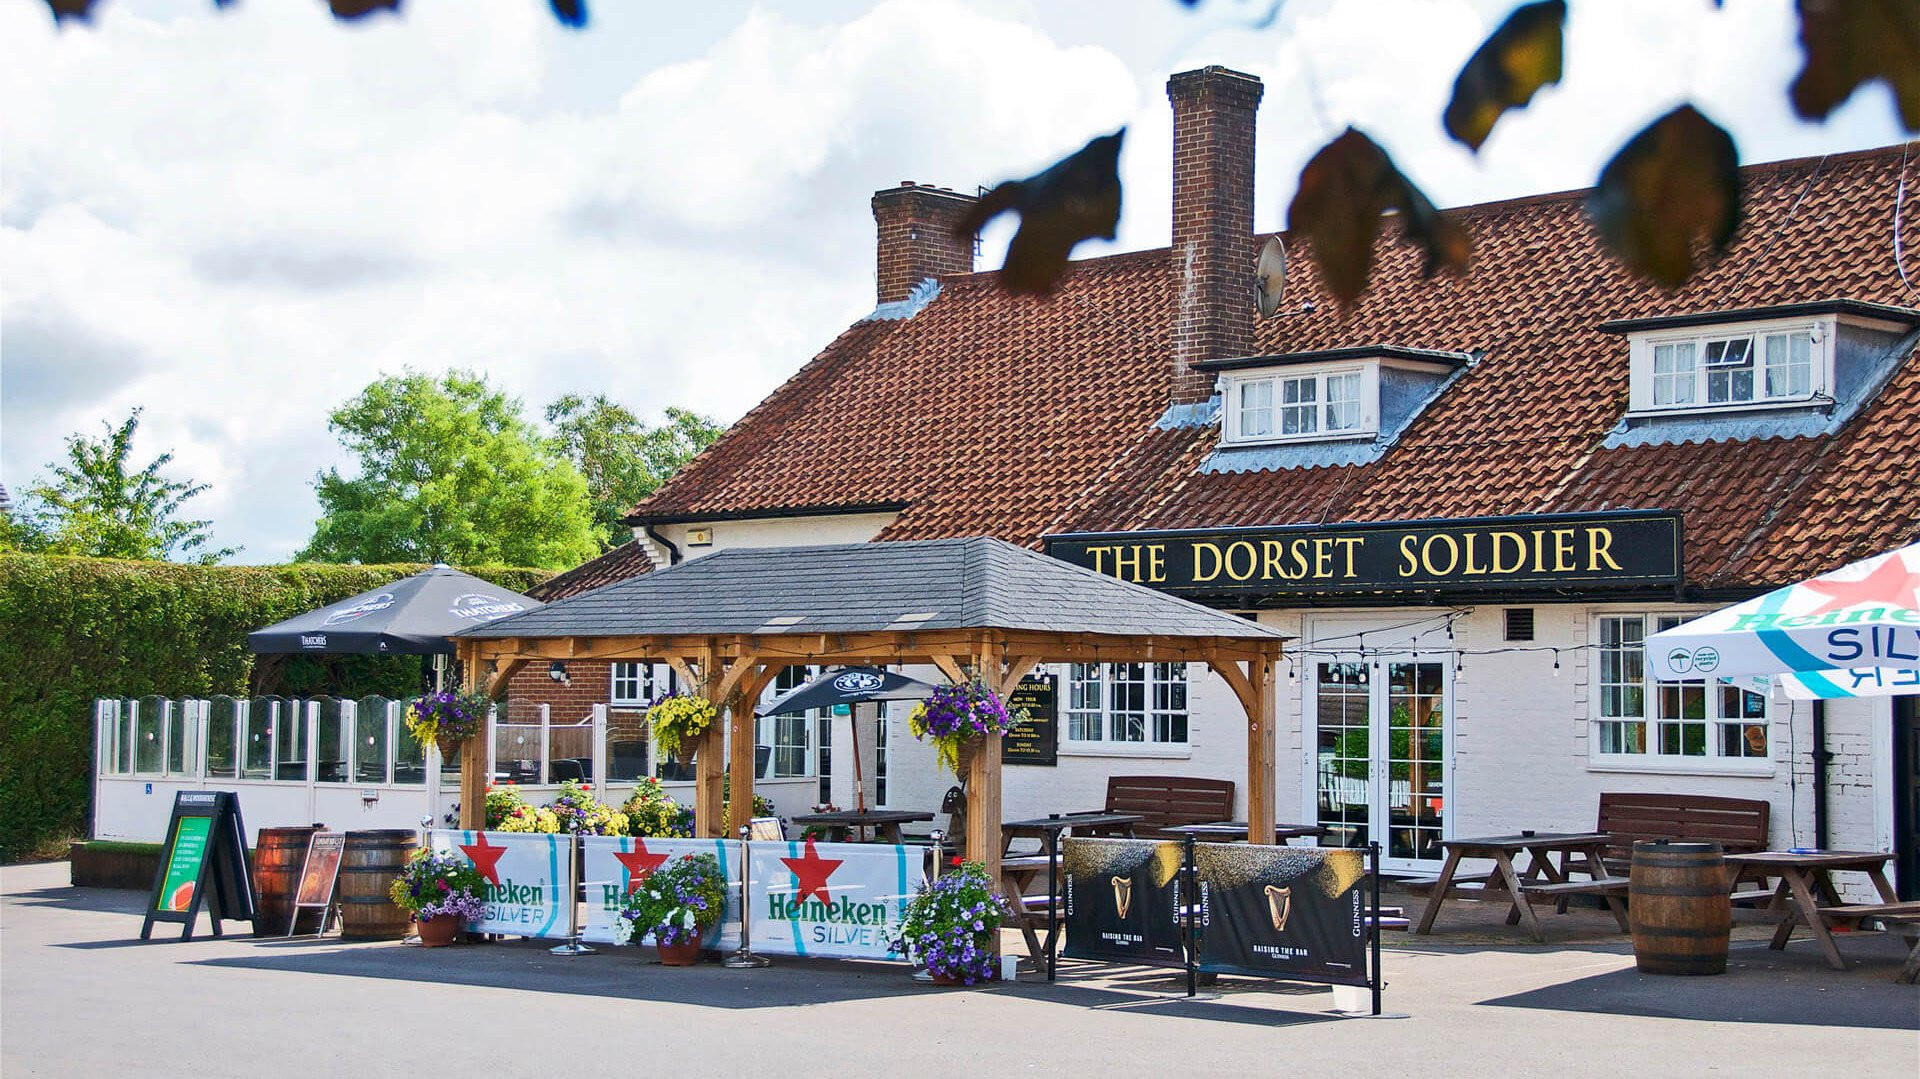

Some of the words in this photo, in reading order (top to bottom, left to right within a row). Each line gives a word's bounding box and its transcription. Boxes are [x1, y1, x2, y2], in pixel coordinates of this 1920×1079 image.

[1086, 544, 1166, 583] THE
[1192, 537, 1364, 582] DORSET
[1399, 527, 1623, 578] SOLDIER
[302, 635, 327, 646] THATCHERS
[1827, 626, 1920, 661] SIL
[1029, 684, 1052, 692] HOURS
[485, 905, 545, 924] SILVER
[768, 893, 887, 925] Heineken
[1172, 879, 1180, 924] GUINNESS
[1201, 881, 1210, 926] GUINNESS
[1352, 889, 1361, 938] GUINNESS
[1253, 944, 1280, 954] RAISING
[1281, 947, 1293, 955] THE
[1295, 948, 1308, 957] BAR
